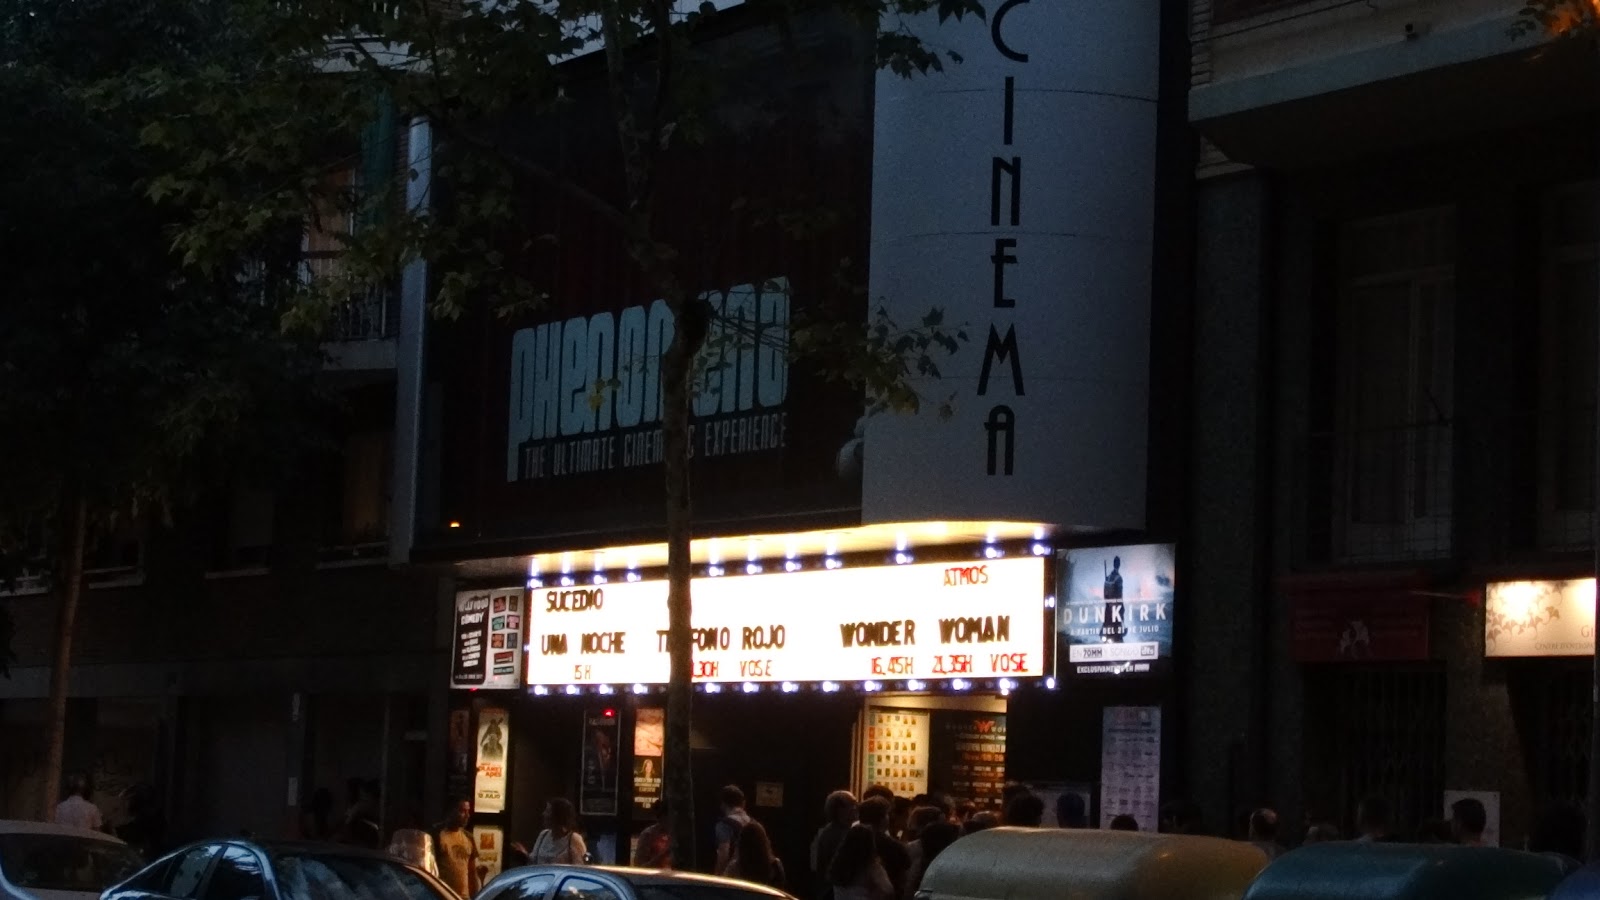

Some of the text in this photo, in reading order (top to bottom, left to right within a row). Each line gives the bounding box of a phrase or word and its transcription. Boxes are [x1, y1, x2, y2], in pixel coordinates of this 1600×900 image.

[977, 0, 1025, 476] CINEMA
[525, 412, 788, 479] THE ULTIMATE CINEMC EXPERIENCE
[944, 565, 988, 586] ATMOS
[1063, 603, 1167, 625] DUNKIRK
[742, 625, 785, 650] ROJO
[840, 615, 1010, 648] WONDER WOMAN
[1103, 626, 1116, 634] DEL
[1139, 625, 1160, 633] JULIO
[541, 631, 626, 655] UNA NOCHE
[1083, 648, 1103, 658] 70MM
[740, 659, 773, 677] VOSE
[990, 653, 1029, 673] VOSE
